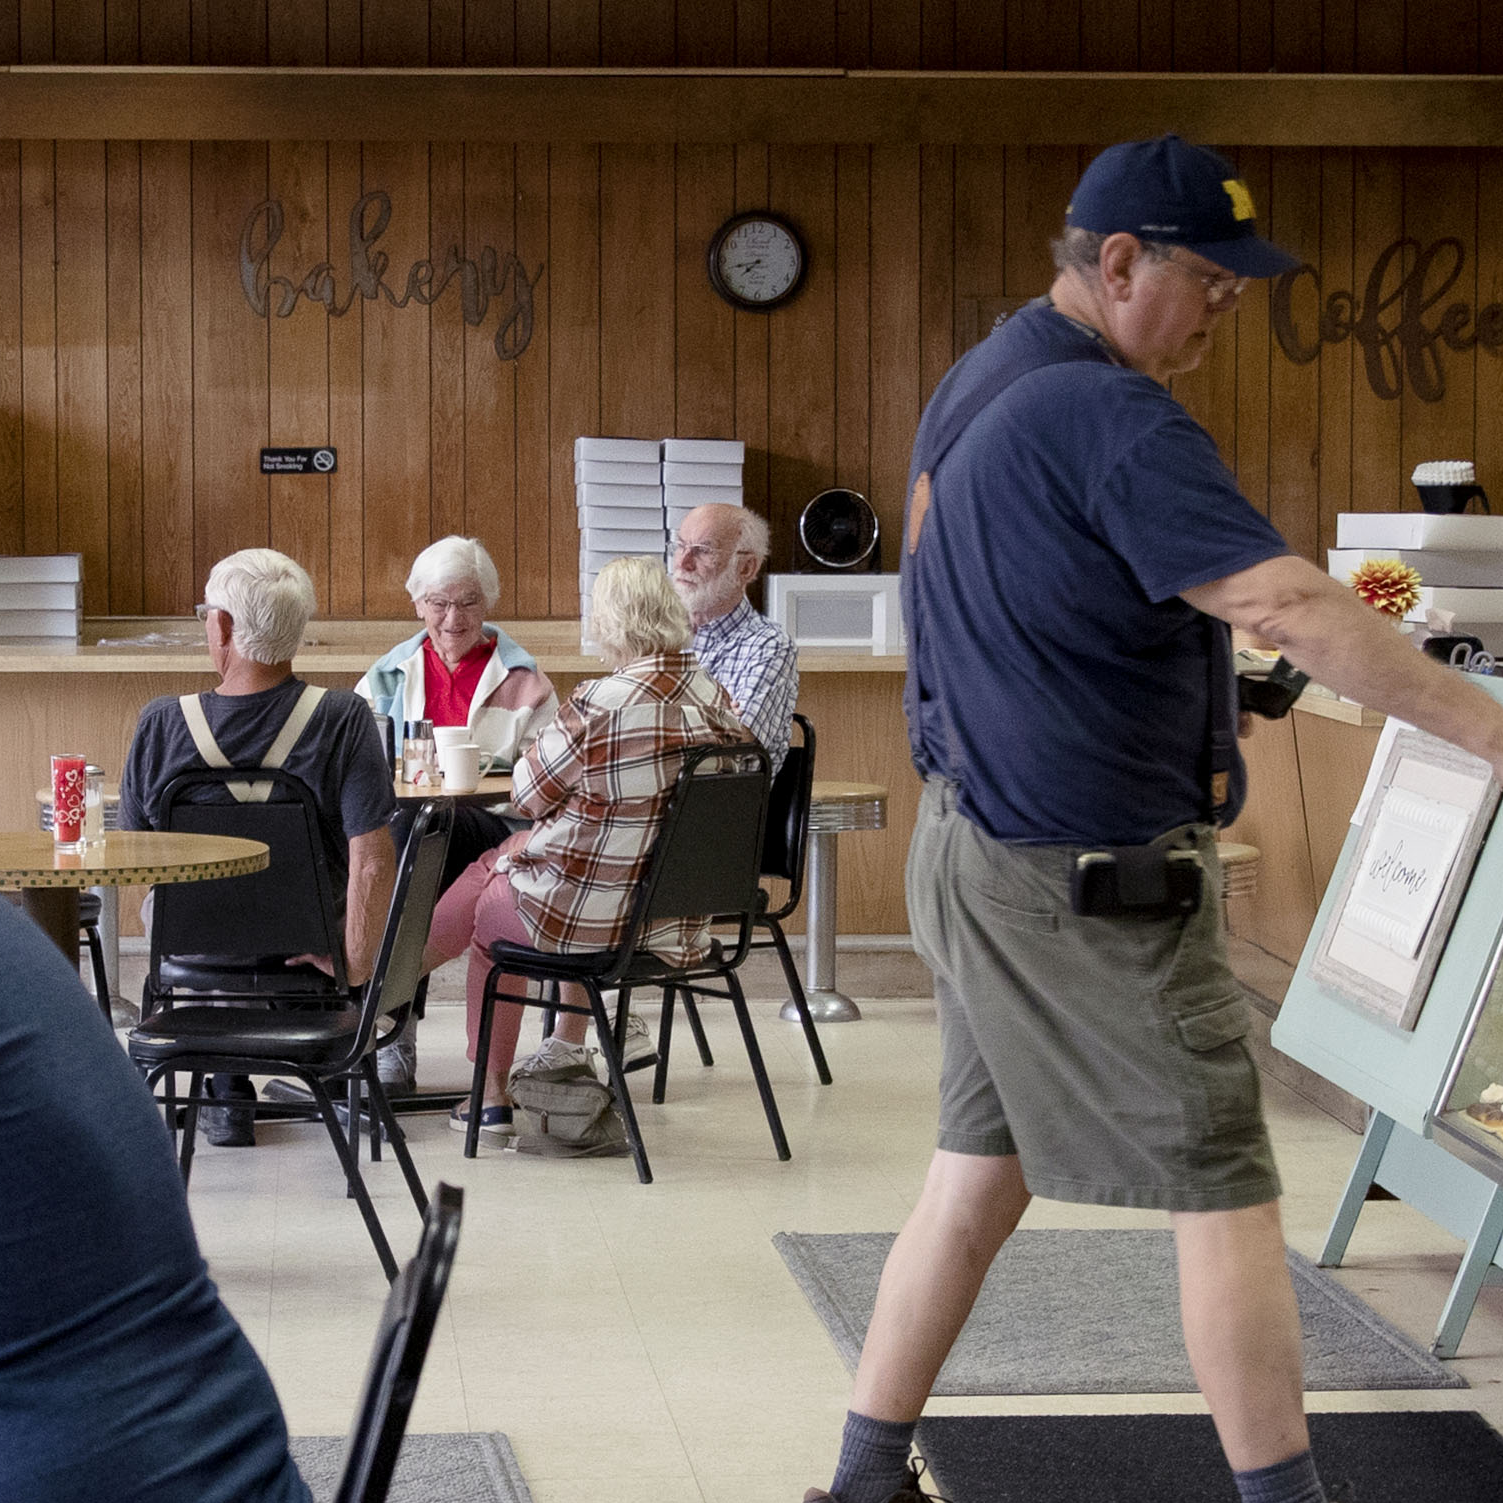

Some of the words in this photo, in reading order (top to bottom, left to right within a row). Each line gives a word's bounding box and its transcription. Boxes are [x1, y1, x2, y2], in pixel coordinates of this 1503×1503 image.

[738, 228, 747, 238] 11
[752, 224, 764, 234] 12
[239, 190, 544, 361] bakery
[276, 462, 304, 471] Smoking
[1369, 840, 1427, 895] welcome
